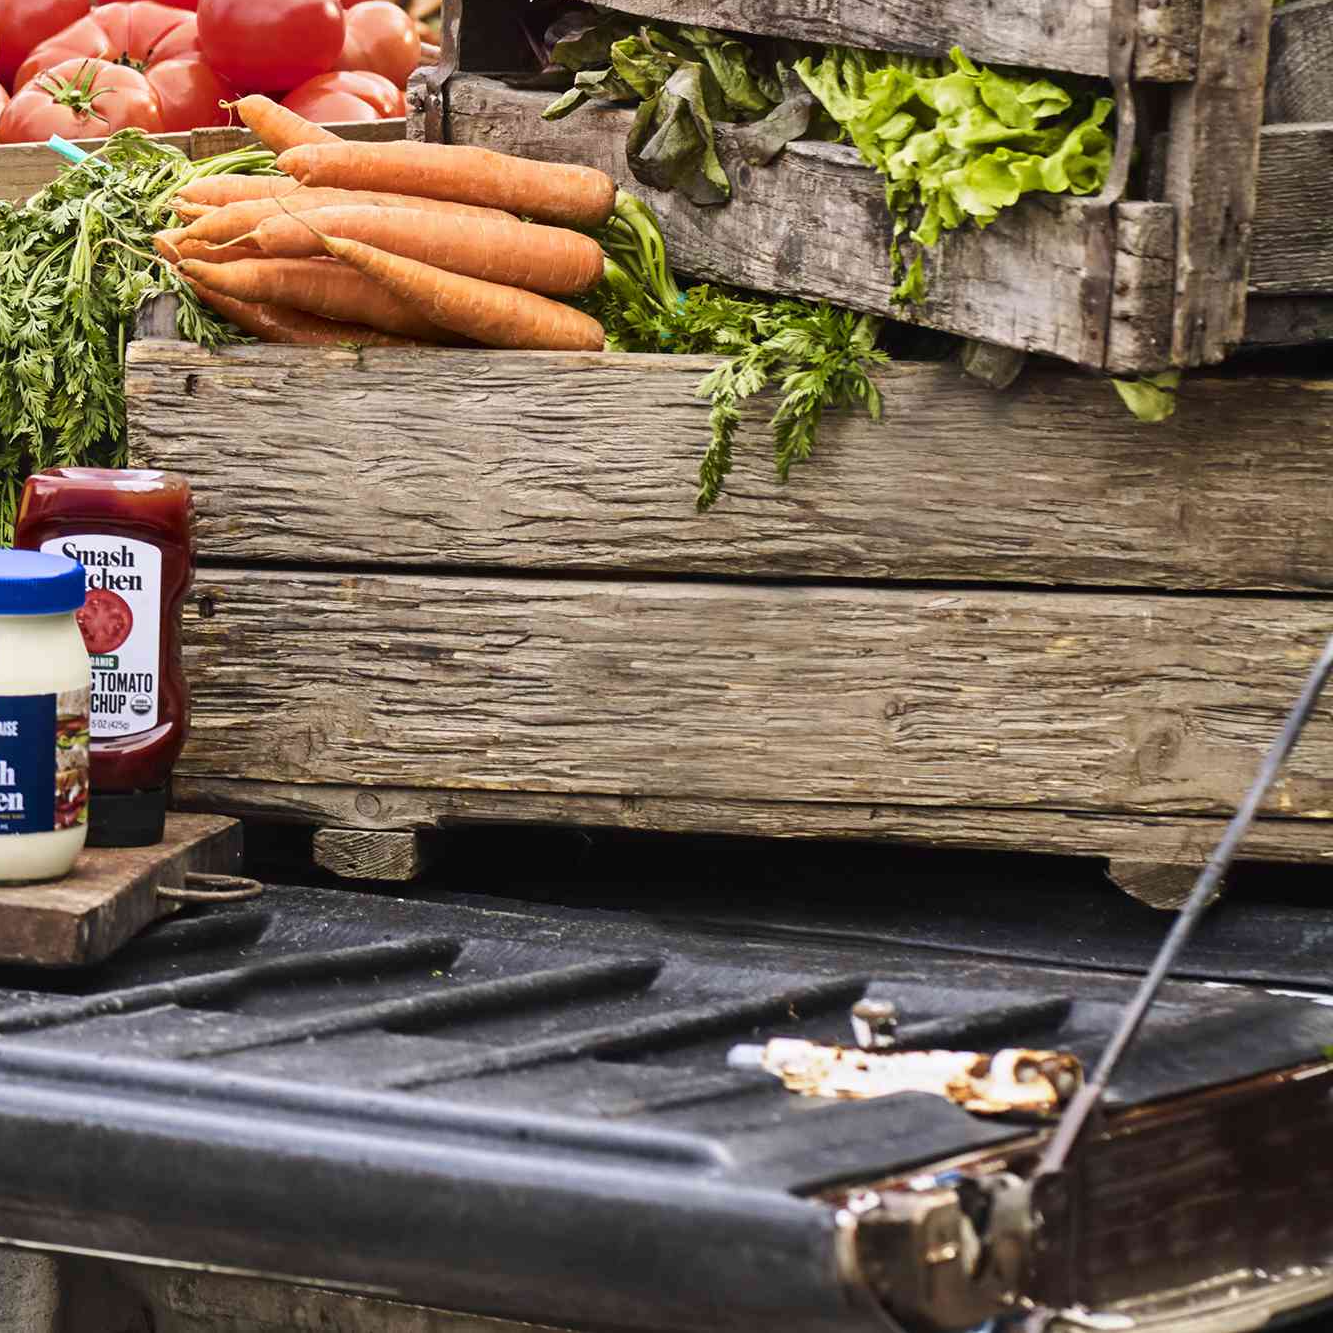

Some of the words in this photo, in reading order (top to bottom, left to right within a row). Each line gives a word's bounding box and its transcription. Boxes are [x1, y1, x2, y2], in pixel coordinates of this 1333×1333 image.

[62, 542, 135, 567] Smash
[85, 567, 142, 591] chen
[99, 672, 153, 693] TOMATO
[91, 693, 126, 714] CHUP
